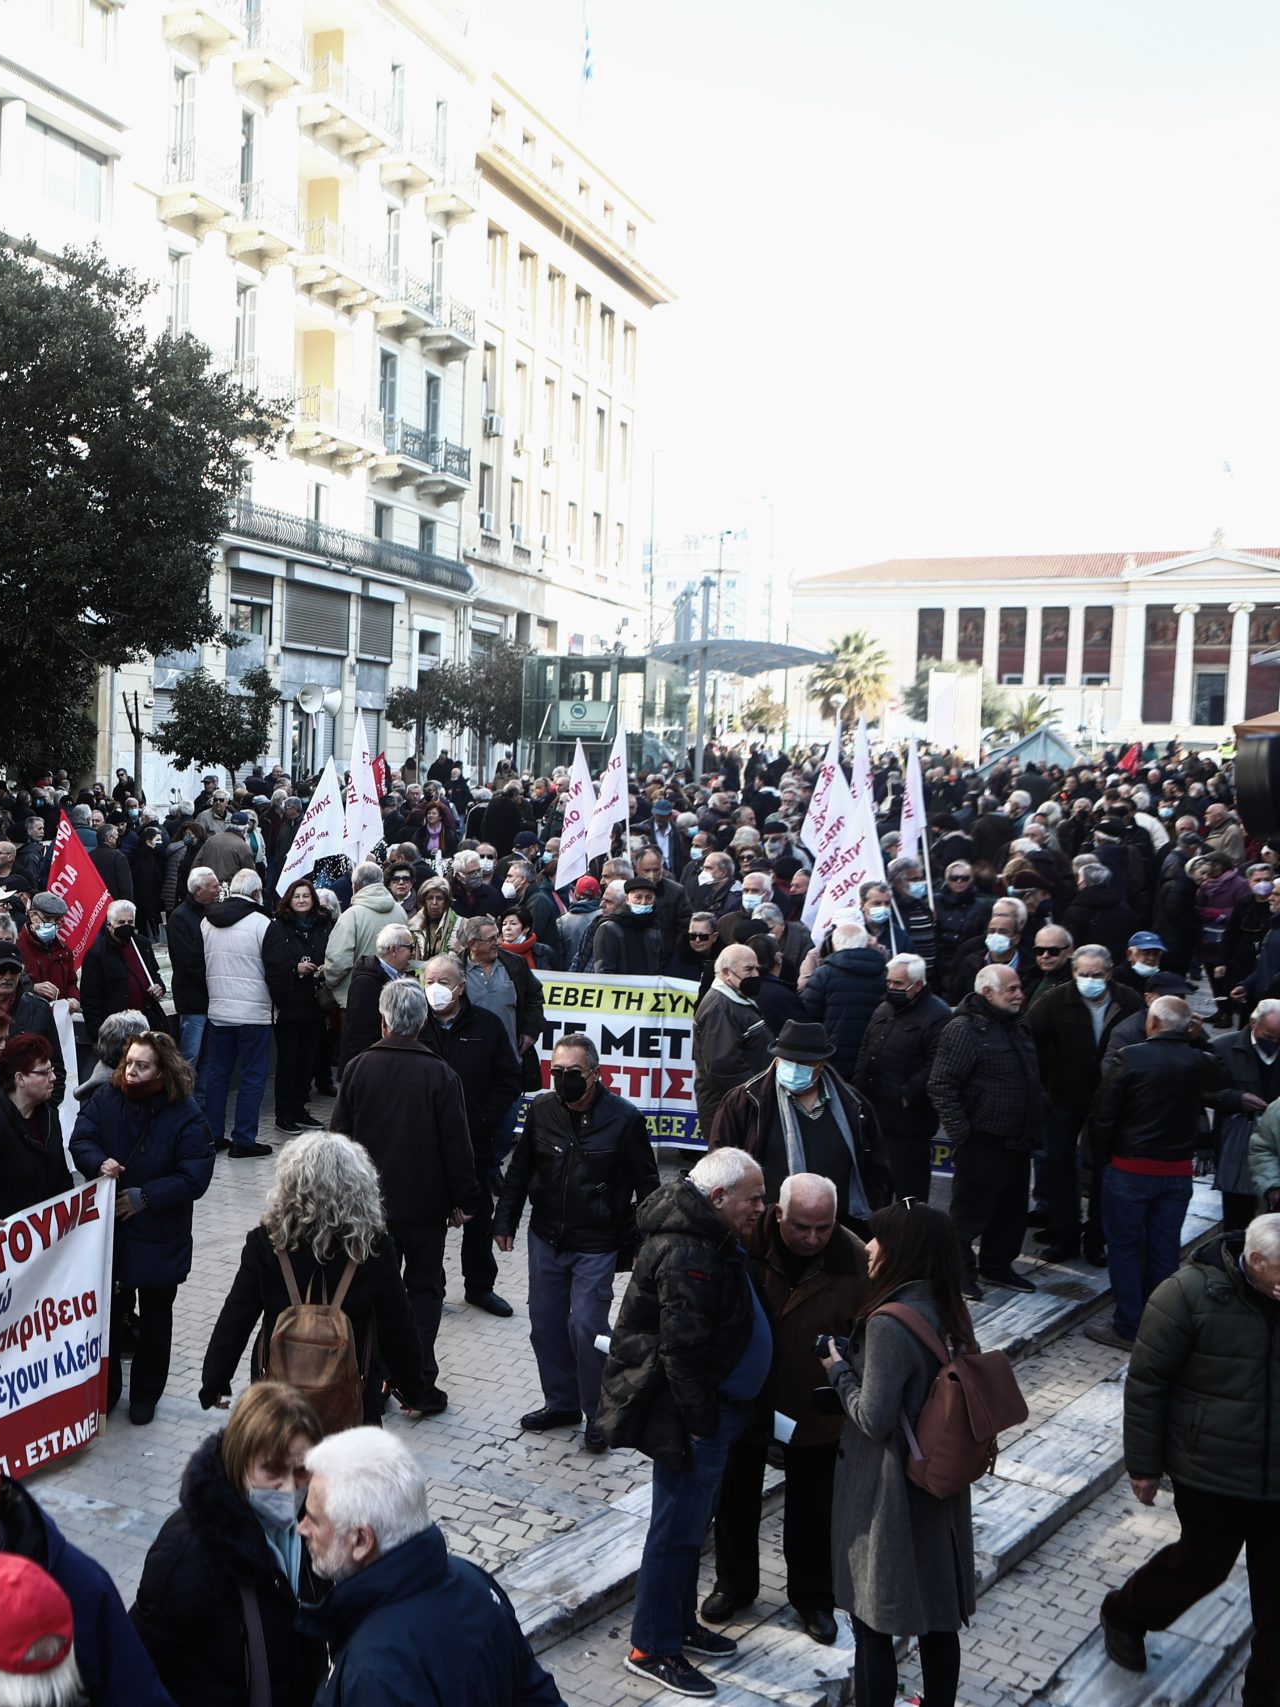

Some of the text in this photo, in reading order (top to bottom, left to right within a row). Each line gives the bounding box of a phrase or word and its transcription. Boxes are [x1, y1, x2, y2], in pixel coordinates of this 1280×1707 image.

[611, 990, 644, 1011] ΤΗ
[600, 1024, 693, 1060] ΜΕΤ
[25, 1409, 99, 1468] ΕΣΤΑΜΕ
